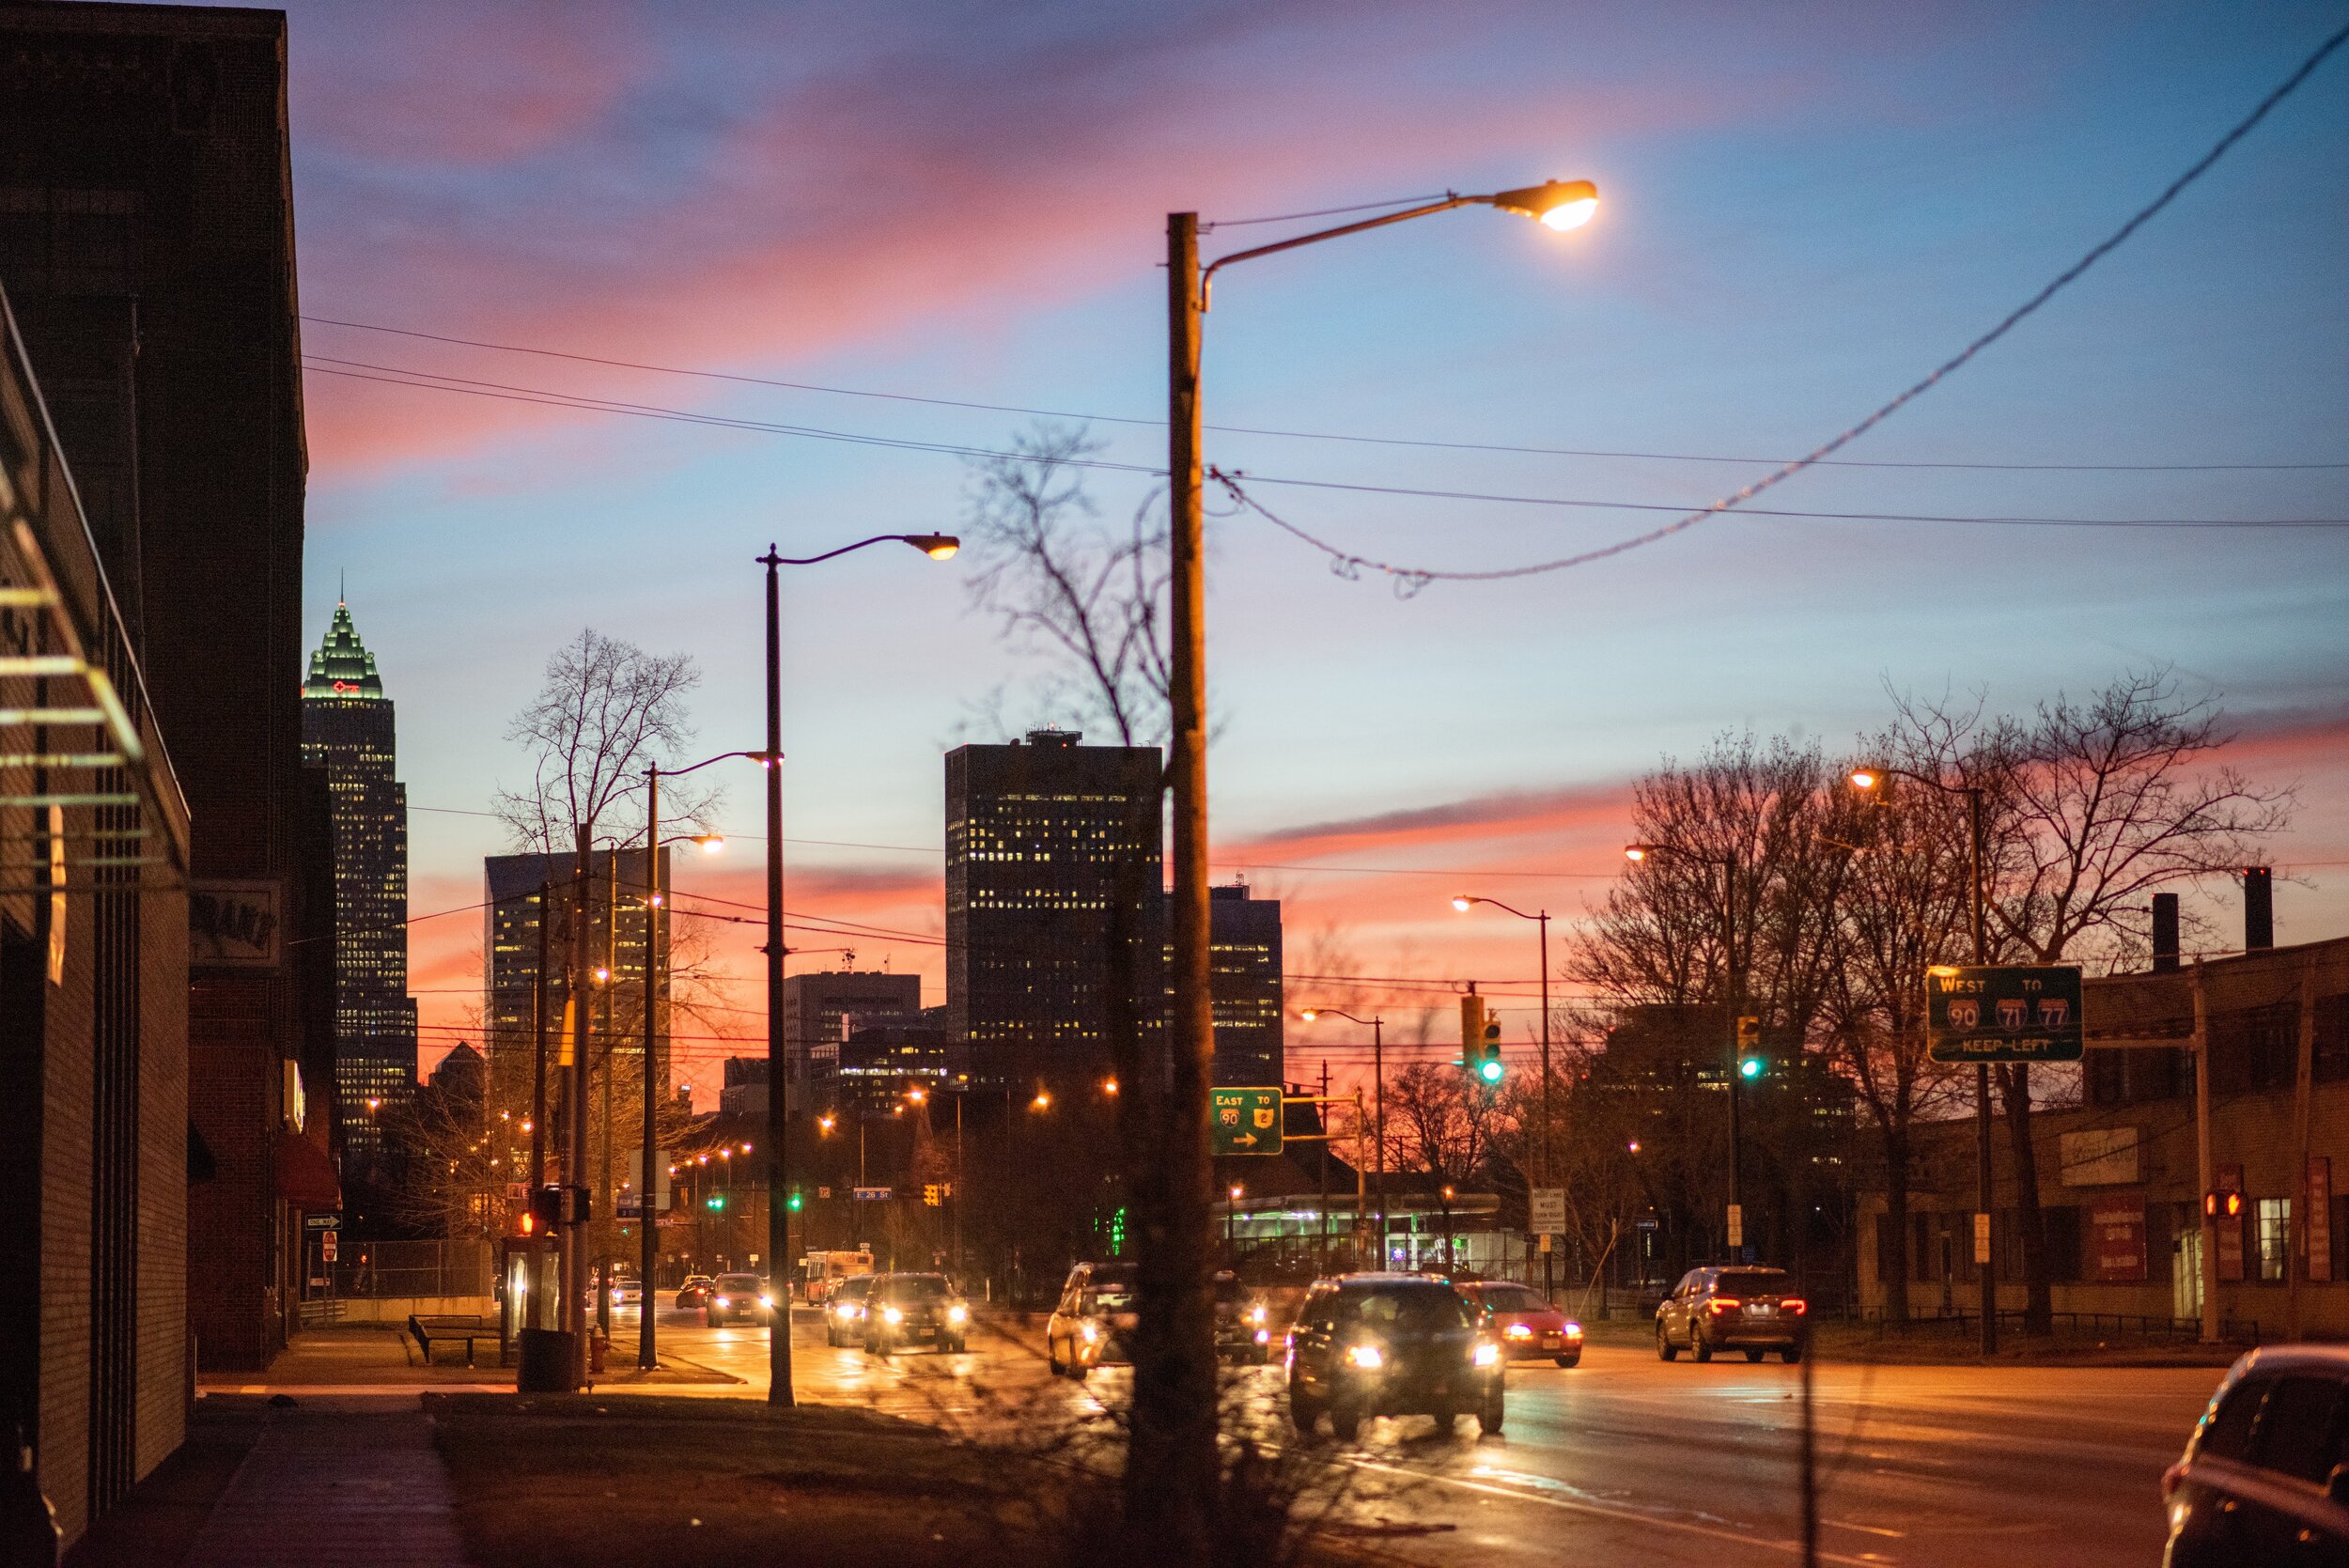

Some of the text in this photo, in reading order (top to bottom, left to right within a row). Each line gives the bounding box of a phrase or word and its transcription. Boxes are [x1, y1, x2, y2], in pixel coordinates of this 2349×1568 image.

[1939, 977, 2043, 993] WEST TO
[1951, 1008, 2065, 1027] 90 71 77
[1963, 1039, 2049, 1052] KEEP LEFT
[1216, 1095, 1270, 1106] EAST TO
[1221, 1113, 1268, 1125] 90 2
